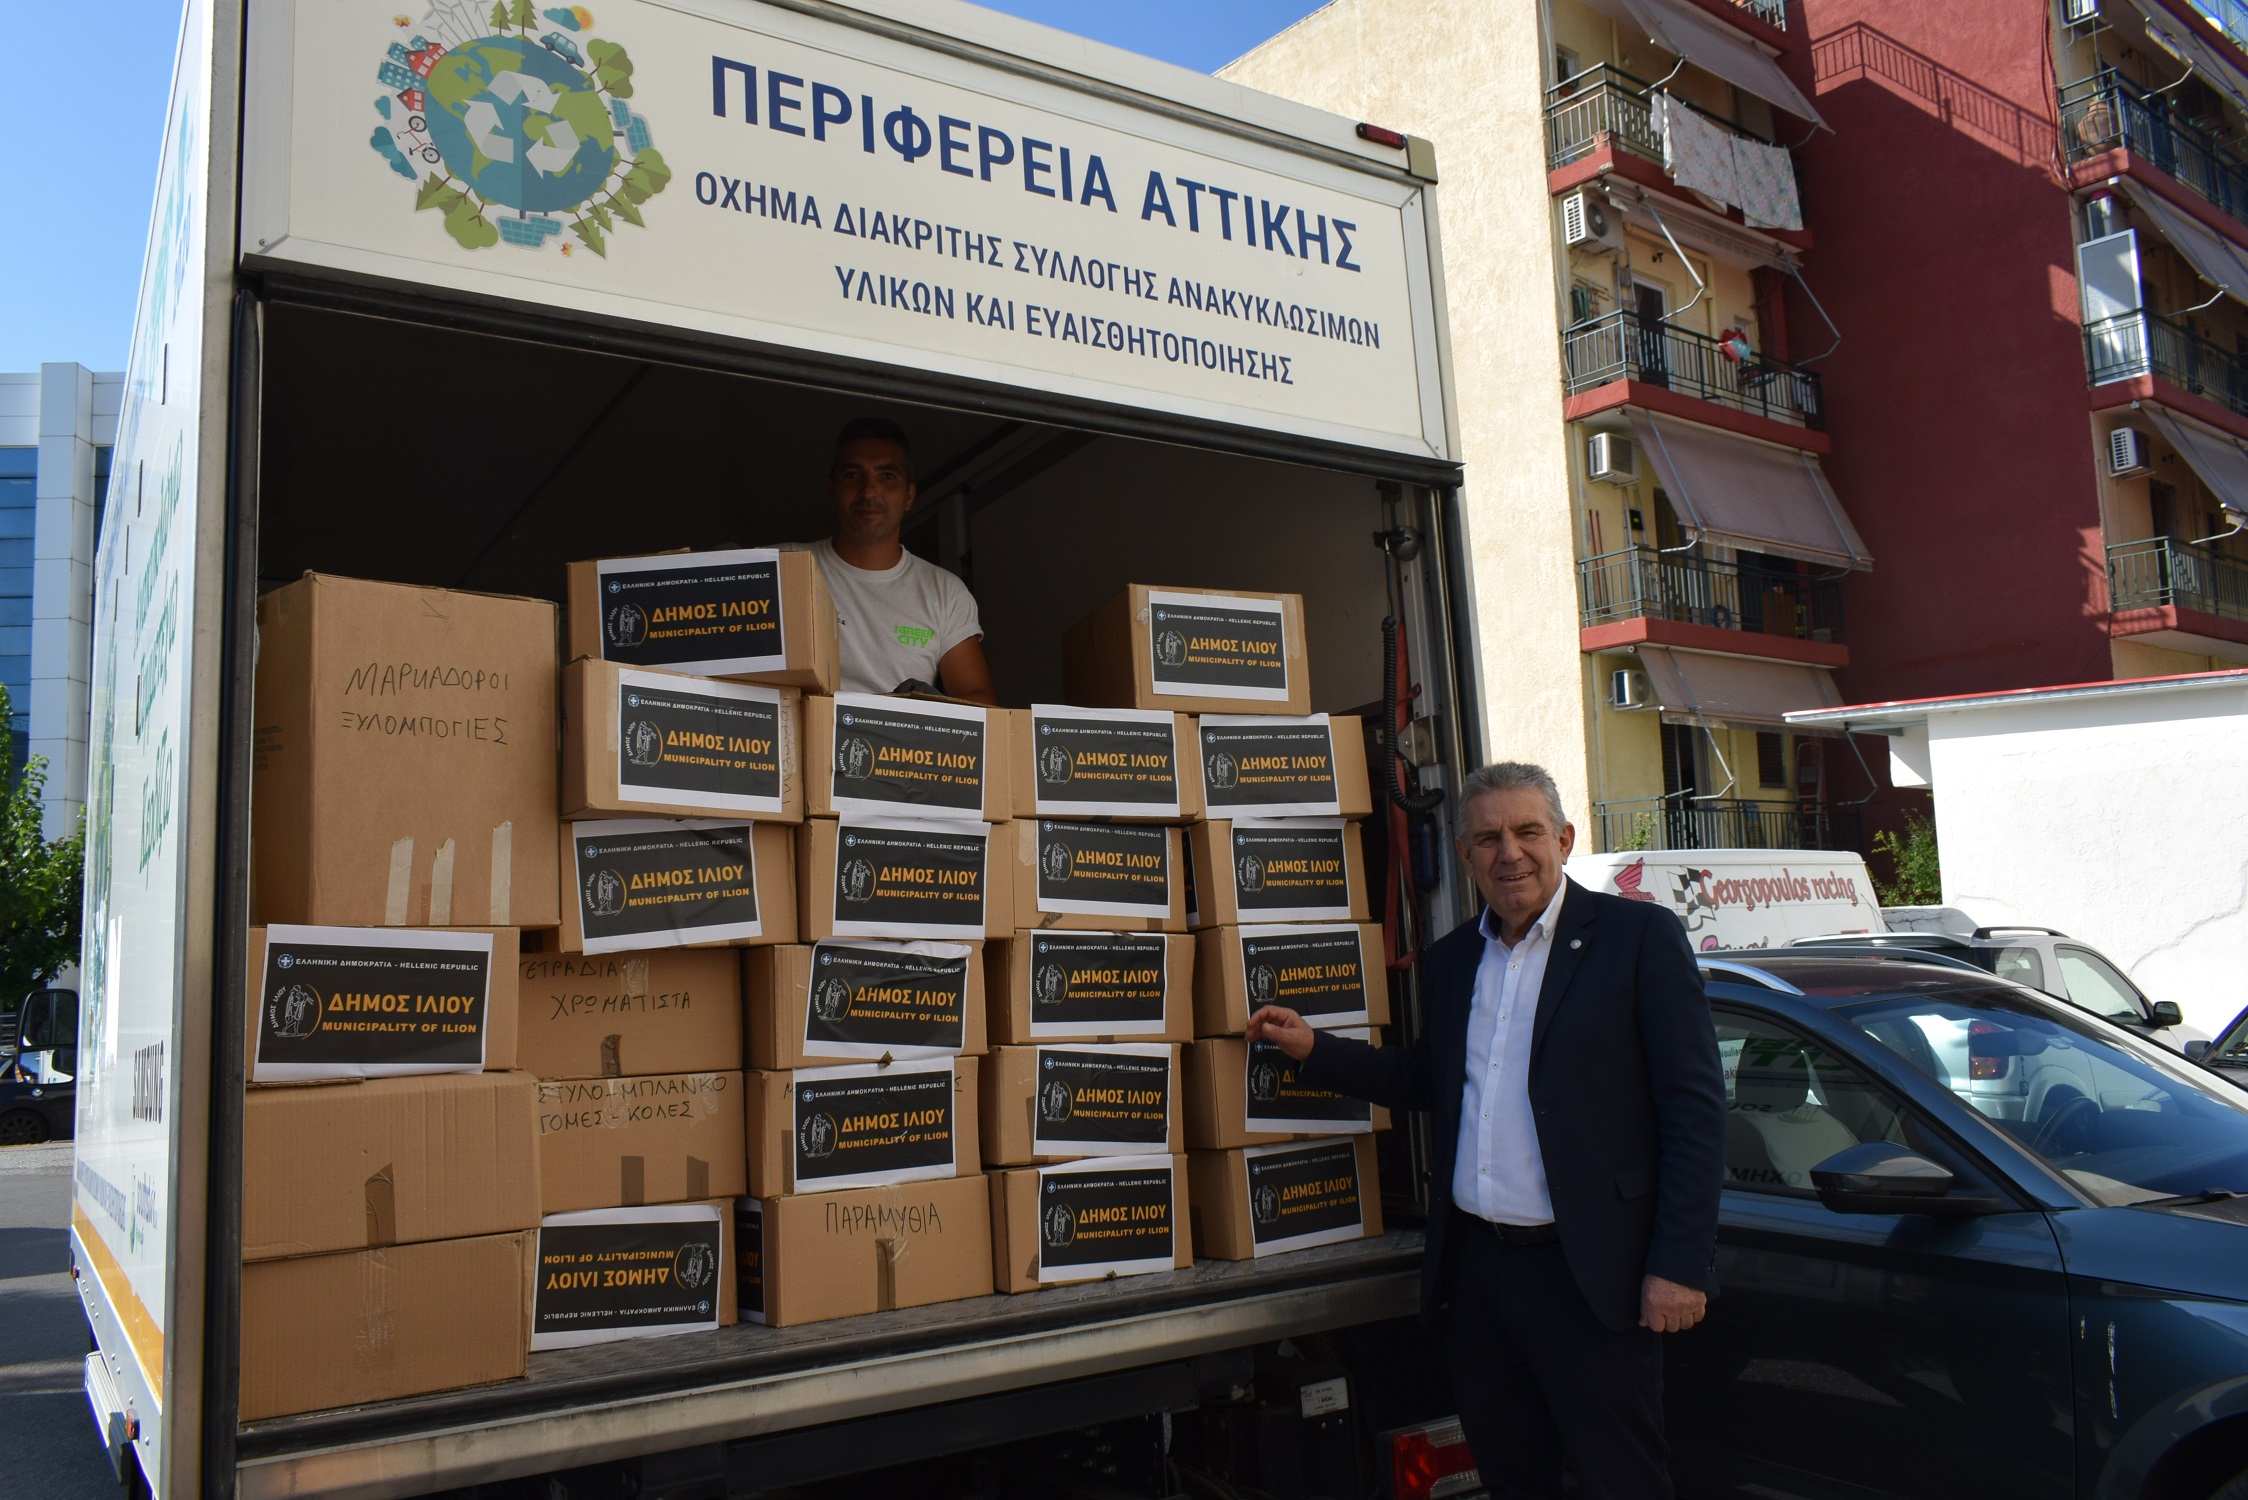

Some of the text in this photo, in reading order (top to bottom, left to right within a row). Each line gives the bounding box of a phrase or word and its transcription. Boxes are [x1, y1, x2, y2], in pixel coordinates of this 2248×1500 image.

[712, 55, 1361, 273] ΠΕΡΙΦΕΡΕΙΑ ΑΤΤΙΚΗΣ
[695, 171, 1380, 349] ΟΧΗΜΑ ΔΙΑΚΡΙΤΗΣ ΣΥΛΛΟΓΗΣ ΑΝΑΚΥΚΛΩΣΙΜΩΝ
[835, 265, 1294, 385] ΥΛΙΚΩΝ ΚΑΙ ΕΥΑΙΣΘΗΤΟΠΟΙΗΣΗΣ
[621, 572, 770, 589] ΕΛΛΗΝΙΚΗ ΔΗΜΟΚΡΑΤΙΑ HELLENIC REPUBLIC
[651, 599, 770, 622] ΔΗΜΟΣ ΙΛΙΟΥ
[648, 621, 775, 638] MUNICIPALITY OF ILION
[898, 625, 935, 640] GREEN
[897, 634, 929, 649] CITY
[1189, 636, 1277, 654] ΔΗΜΟΣ ΙΛΙΟΥ
[1187, 655, 1281, 668] MUNICIPALITY OF ILION
[640, 698, 772, 720] ΕΛΛΗΝΙΚΗ ΔΗΜΟΚΡΑΤΙΑ HELLENIC REPUBLIC
[666, 729, 771, 755] ΔΗΜΟΣ ΙΛΙΟΥ
[663, 753, 775, 771] MUNICIPALITY OF ILION
[877, 745, 976, 770] ΔΗΜΟΣ ΙΛΙΟΥ
[1075, 751, 1168, 768] ΔΗΜΟΣ ΙΛΙΟΥ
[1239, 755, 1327, 770] ΔΗΜΟΣ ΙΛΙΟΥ
[873, 767, 978, 785] MUNICIPALITY OF ILION
[1073, 771, 1172, 782] MUNICIPALITY OF ILION
[1239, 775, 1296, 783] MUNICIPALITY
[1075, 849, 1161, 869] ΔΗΜΟΣ ΙΛΙΟΥ
[1266, 859, 1340, 873] ΔΗΜΟΣ ΙΛΙΟΥ
[629, 864, 746, 889] ΔΗΜΟΣ ΙΛΙΟΥ
[879, 866, 977, 885] ΔΗΜΟΣ ΙΛΙΟΥ
[1072, 870, 1164, 883] MUNICIPALITY OF ILION
[628, 887, 749, 906] MUNICIPALITY OF ILION
[875, 888, 980, 901] MUNICIPALITY OF ILION
[1699, 867, 1859, 911] Georgopoulos racing
[339, 959, 392, 967] ΔΗΜΟΚΡΑΤΙΑ
[399, 961, 439, 969] HELLENIC
[439, 963, 478, 971] REPUBLIC
[1278, 963, 1357, 982] ΔΗΜΟΣ ΙΛΙΟΥ
[1070, 969, 1158, 983] ΔΗΜΟΣ ΙΛΙΟΥ
[855, 985, 956, 1007] ΔΗΜΟΣ ΙΛΙΟΥ
[1067, 990, 1124, 998] MUNICIPALITY
[1126, 990, 1138, 998] OF
[1278, 982, 1361, 995] MUNICIPALITY OF ILION
[327, 992, 474, 1014] ΔΗΜΟΣ ΙΛΙΟΥ
[849, 1008, 958, 1022] MUNICIPALITY OF ILION
[321, 1021, 476, 1033] MUNICIPALITY OF ILION
[1075, 1087, 1161, 1105] ΔΗΜΟΣ ΙΛΙΟΥ
[841, 1108, 945, 1133] ΔΗΜΟΣ ΙΛΙΟΥ
[1071, 1109, 1164, 1120] MUNICIPALITY OF ILION
[838, 1130, 948, 1149] MUNICIPALITY OF ILION
[1281, 1176, 1353, 1201] ΔΗΜΟΣ ΙΛΙΟΥ
[1078, 1204, 1166, 1224] ΔΗΜΟΣ ΙΛΙΟΥ
[1280, 1200, 1328, 1215] MUNICIPALITY
[1328, 1198, 1338, 1206] OF
[825, 1202, 942, 1236] ΠΑΡΑΜΥΘΙΑ
[1076, 1225, 1169, 1239] MUNICIPALITY OF ILION
[543, 1250, 675, 1264] MUNICIPALITY OF ILION
[546, 1267, 669, 1289] ΔΗΜΟΣ ΙΛΙΟΥ
[543, 1304, 696, 1320] ΕΛΛΗΝΙΚΗ ΔΗΜΟΚΡΑΤΙΑ HELLENIC REPUBLIC
